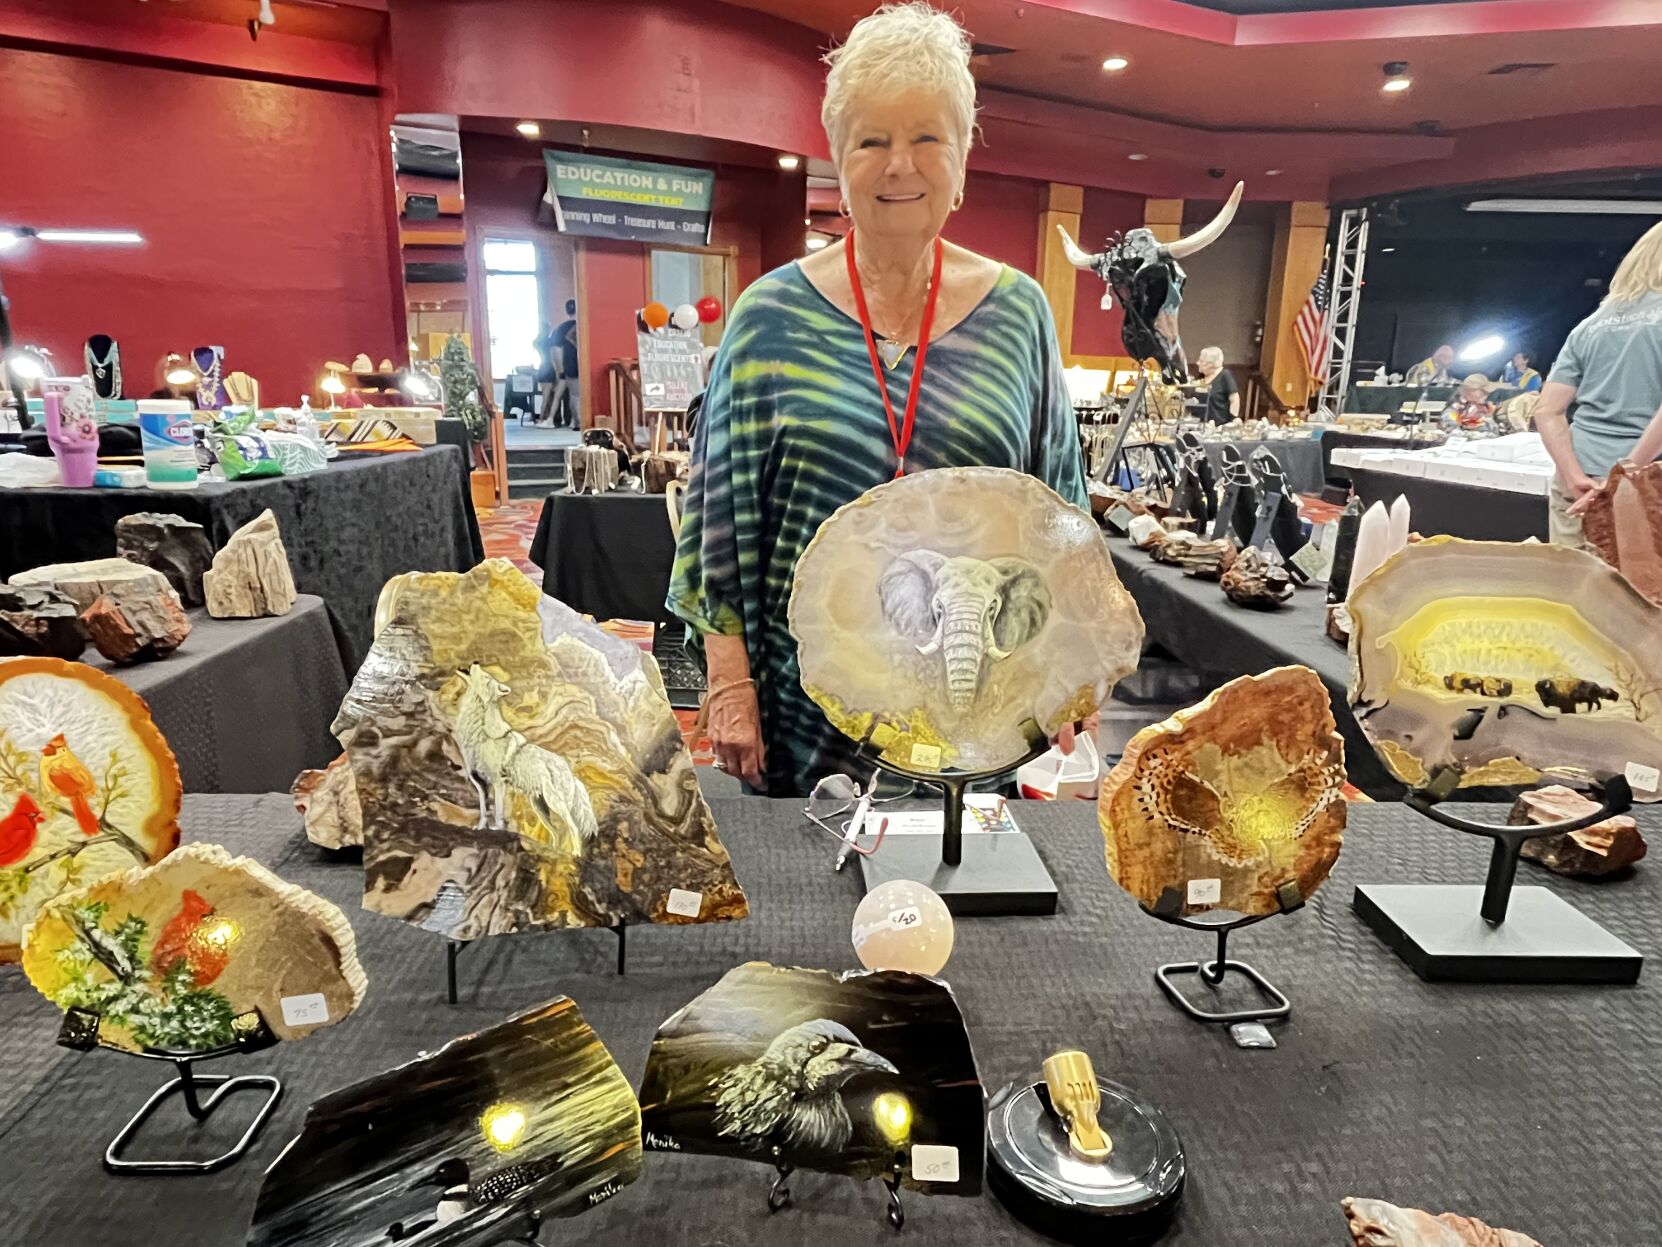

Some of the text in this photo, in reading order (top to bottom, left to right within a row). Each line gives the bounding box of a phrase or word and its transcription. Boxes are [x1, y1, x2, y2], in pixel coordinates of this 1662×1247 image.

[556, 165, 703, 195] EDUCATION & FUN
[592, 213, 616, 224] Wheel
[624, 215, 657, 229] Treasure
[658, 219, 675, 230] Hunt
[683, 221, 705, 233] Crafts
